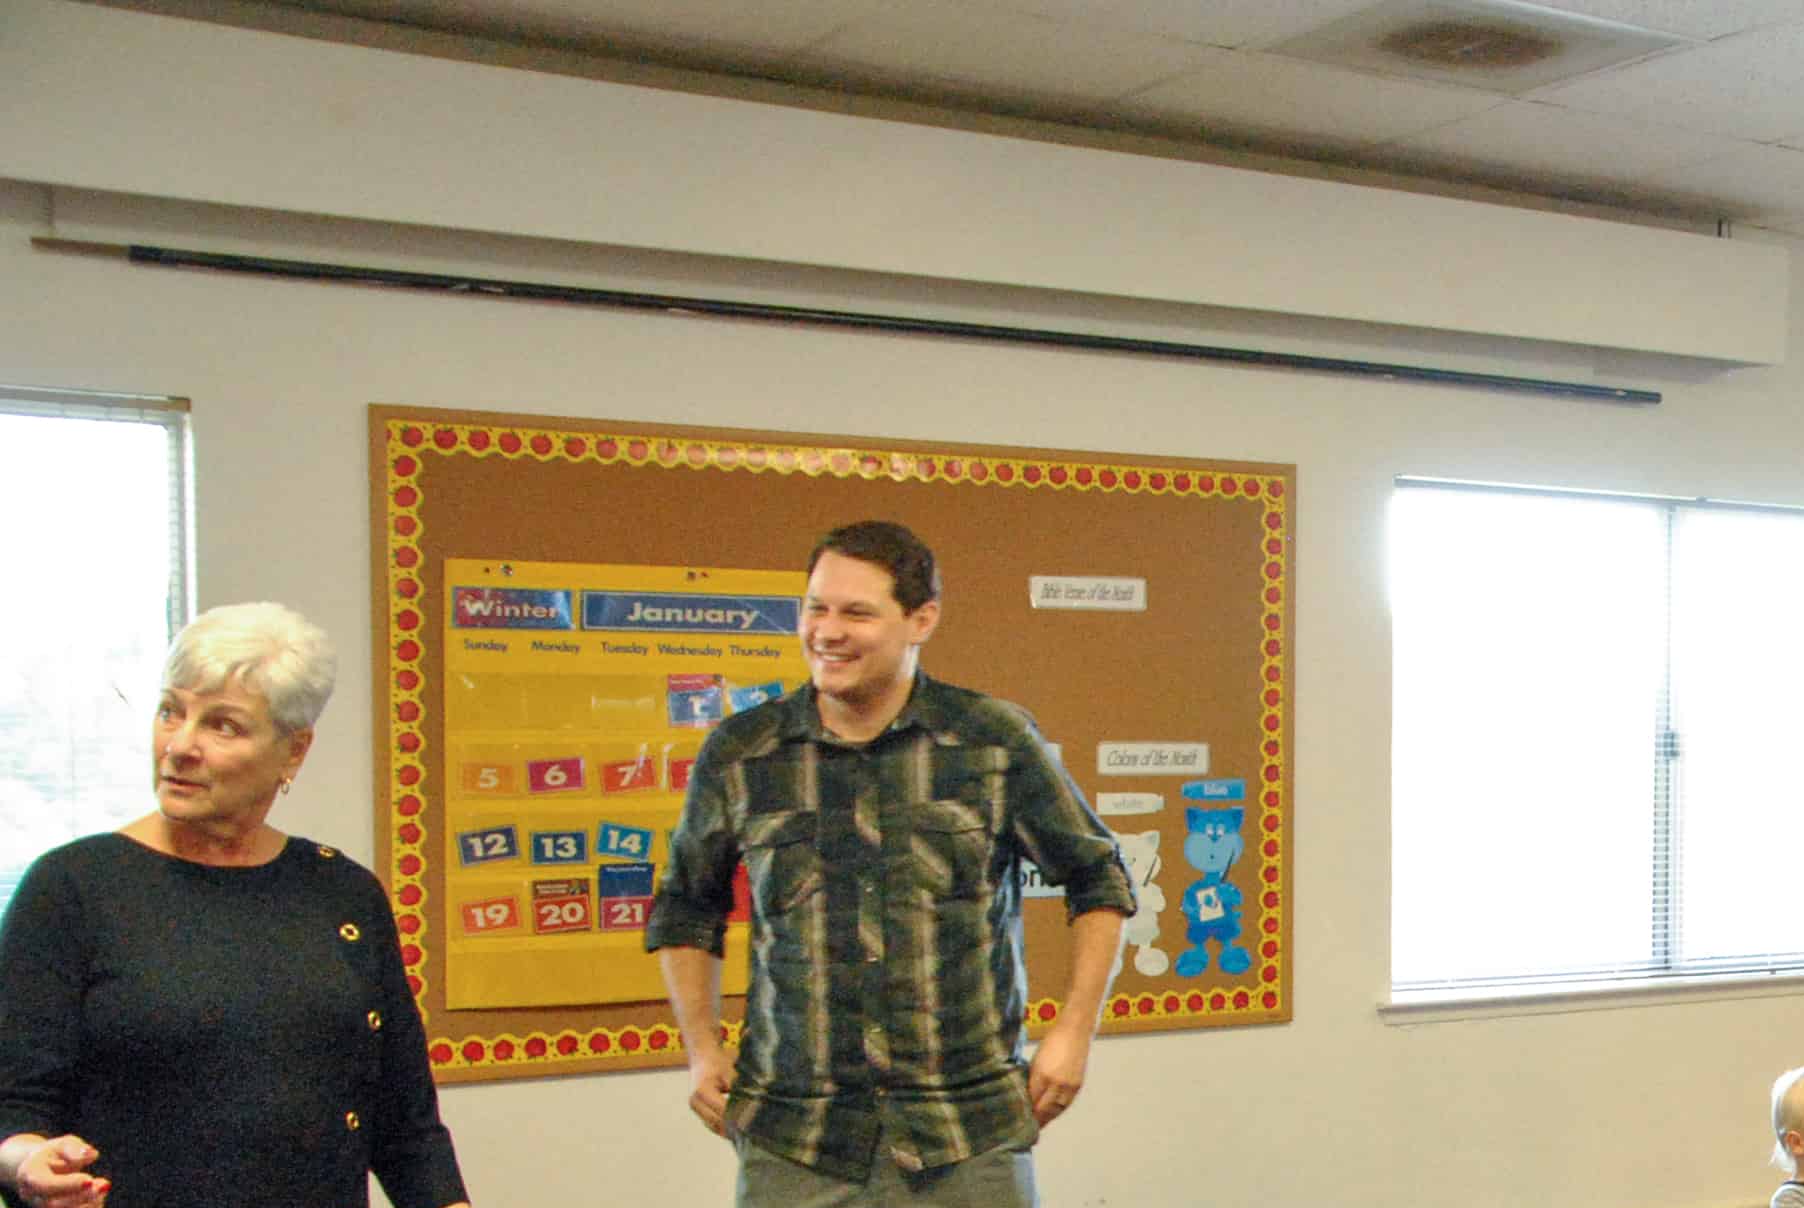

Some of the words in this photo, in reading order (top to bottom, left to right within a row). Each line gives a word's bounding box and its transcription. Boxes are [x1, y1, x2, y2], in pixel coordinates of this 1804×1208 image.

[462, 597, 559, 619] Winter
[627, 602, 759, 629] January
[464, 638, 508, 654] Sunday
[531, 640, 580, 654] Monday
[601, 641, 648, 655] Tuesday
[657, 643, 722, 658] Wednesday
[728, 644, 781, 658] Thursday
[1107, 750, 1138, 767] Colors
[1152, 750, 1169, 767] the
[1170, 750, 1198, 767] Month
[479, 768, 499, 788] 5
[544, 765, 567, 786] 6
[617, 764, 638, 787] 7
[468, 833, 510, 857] 12
[541, 836, 577, 859] 13
[607, 830, 642, 853] 14
[472, 904, 509, 928] 19
[540, 902, 585, 926] 20
[610, 903, 644, 925] 21
